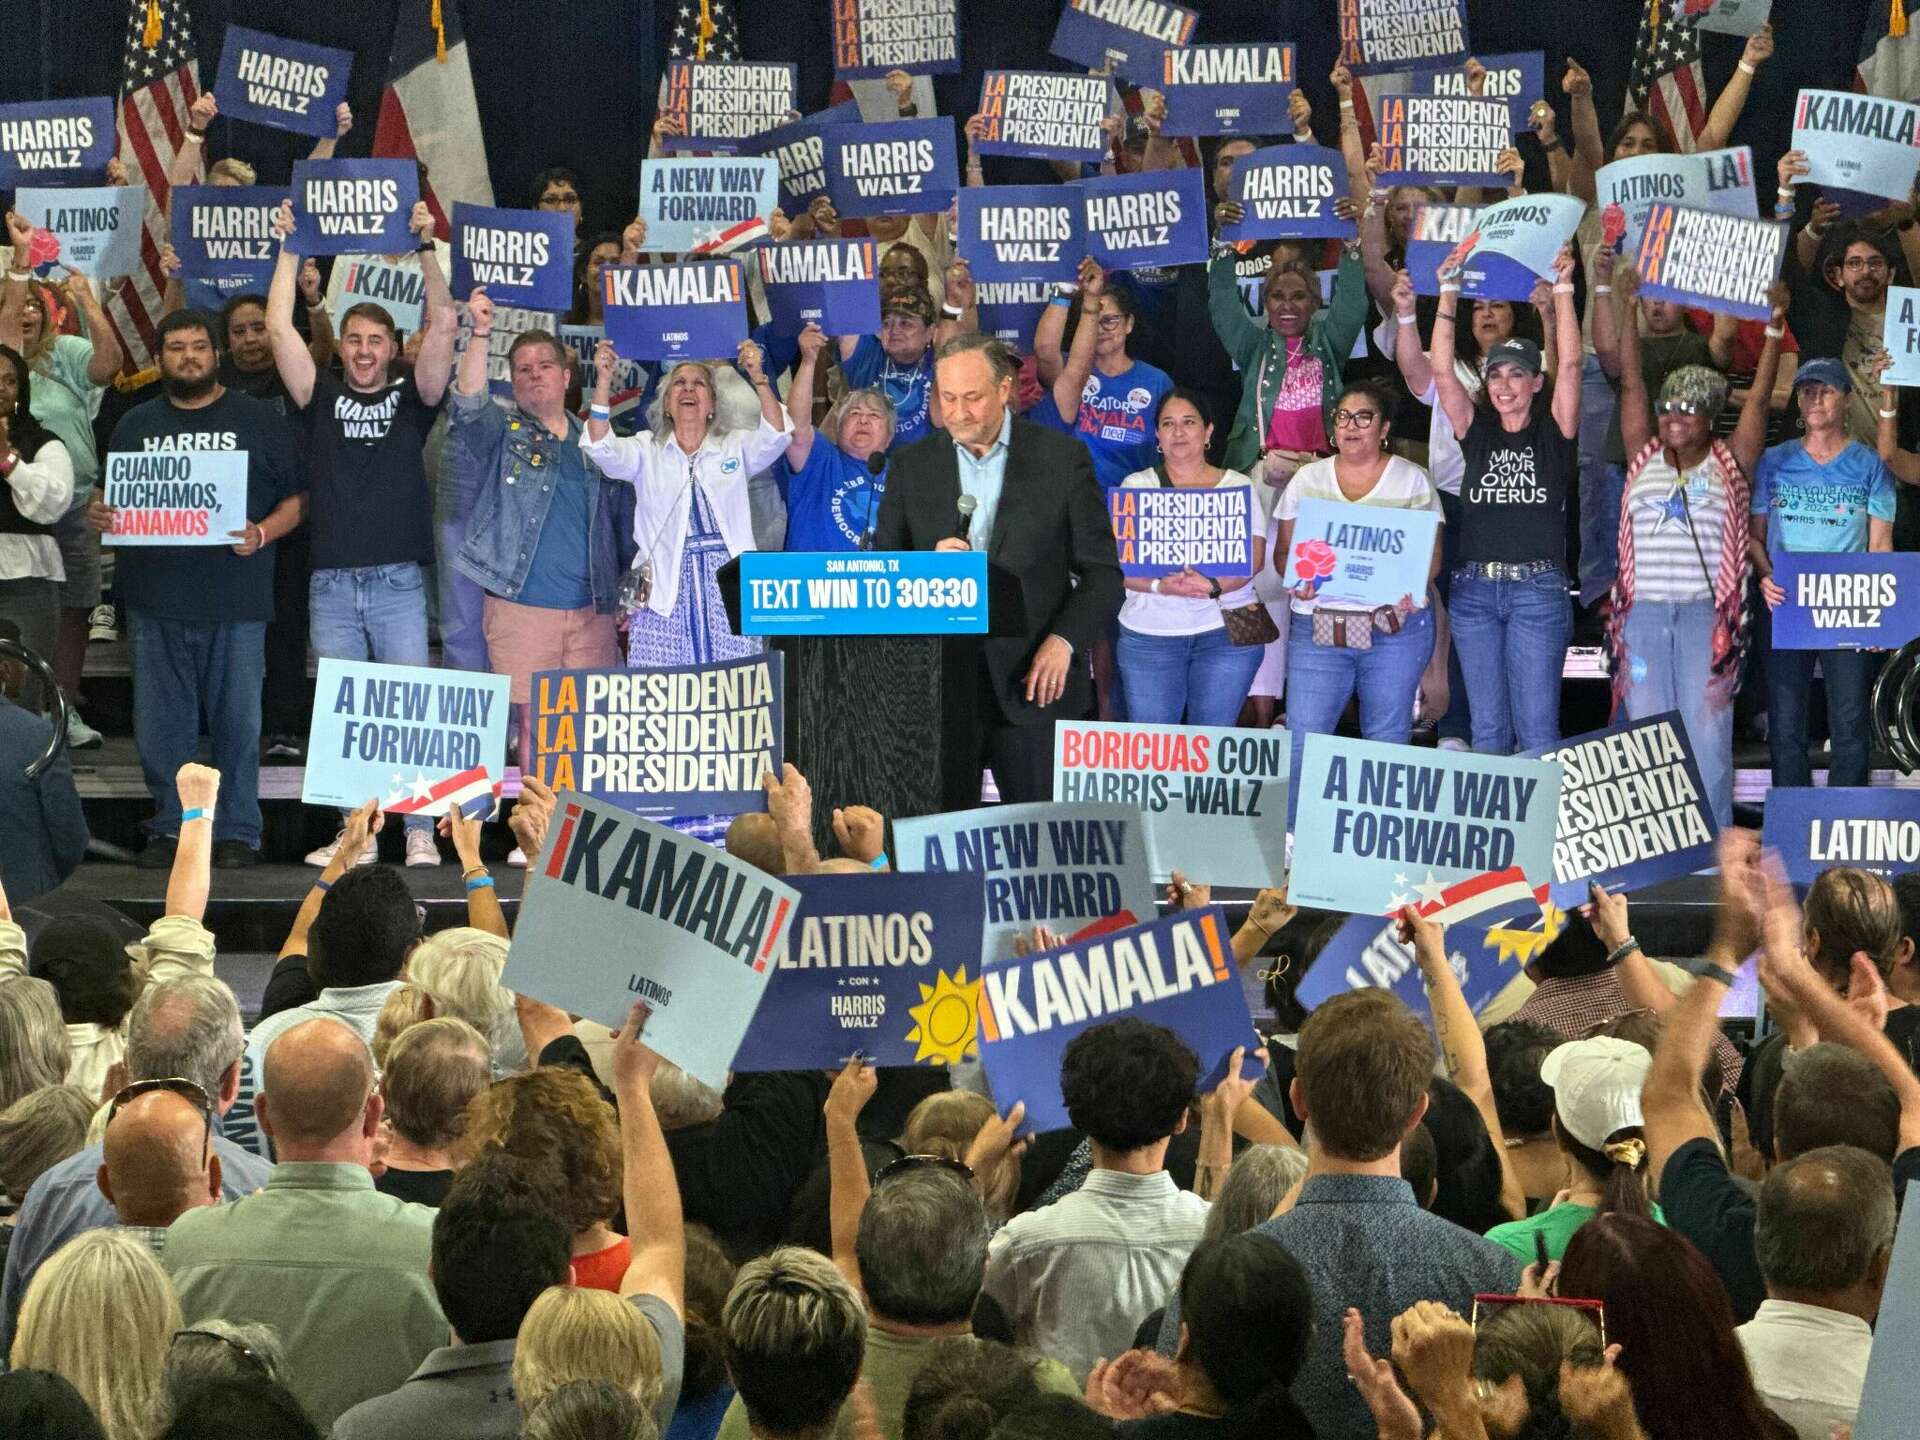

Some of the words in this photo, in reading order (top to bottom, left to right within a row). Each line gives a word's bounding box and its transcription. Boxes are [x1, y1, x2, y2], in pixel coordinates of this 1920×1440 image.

[834, 0, 857, 19] LA
[1341, 16, 1358, 40] LA
[1360, 7, 1462, 39] PRESIDENTA
[836, 21, 858, 44] LA
[860, 13, 956, 43] PRESIDENTA
[838, 44, 859, 68] LA
[861, 37, 956, 66] PRESIDENTA
[1362, 29, 1465, 62] PRESIDENTA
[238, 50, 328, 98] HARRIS
[671, 65, 690, 89] LA
[693, 65, 792, 91] PRESIDENTA
[1164, 48, 1291, 85] ¡KAMALA!
[986, 75, 1006, 96] LA
[1008, 74, 1106, 103] PRESIDENTA
[1434, 69, 1522, 97] HARIS
[248, 84, 310, 115] WALZ
[669, 89, 689, 113] LA
[692, 90, 791, 114] PRESIDENTA
[982, 96, 1001, 117] LA
[1005, 96, 1104, 122] PRESIDENTA
[1383, 99, 1404, 122] LA
[1408, 99, 1511, 128] PRESIDENTA
[2, 117, 93, 151] HARRIS
[1002, 119, 1100, 149] PRESIDENTA
[1382, 124, 1403, 147] LA
[1406, 124, 1510, 150] PRESIDENTA
[18, 149, 81, 169] WALZ
[841, 139, 934, 177] HARRIS
[1405, 149, 1499, 172] PRESIDENT
[652, 168, 665, 192] A
[670, 168, 720, 192] NEW
[721, 168, 764, 192] WAY
[856, 175, 922, 196] WALZ
[1243, 165, 1334, 200] HARRIS
[1612, 173, 1684, 203] LATINOS
[306, 179, 398, 214] HARRIS
[659, 196, 757, 221] FORWARD
[1086, 190, 1181, 231] HARRIS
[1255, 199, 1320, 219] WALZ
[46, 207, 119, 233] LATINOS
[192, 206, 282, 239] HARRIS
[319, 215, 384, 234] WALZ
[981, 207, 1071, 241] HARRIS
[1474, 206, 1551, 232] LATINOS
[1649, 203, 1673, 232] LA
[1676, 208, 1781, 255] PRESIDENTA
[206, 241, 271, 259] WALZ
[463, 225, 549, 266] HARRIS
[995, 243, 1060, 262] WALZ
[1102, 226, 1169, 250] WALZ
[760, 242, 873, 283] ¡KAMALA!
[1642, 231, 1666, 257] LA
[1668, 235, 1777, 282] PRESIDENTA
[472, 263, 534, 286] WALZ
[605, 264, 741, 306] ¡KAMALA!
[1662, 263, 1769, 307] PRESIDENTA
[1899, 298, 1914, 323] A
[143, 432, 237, 452] HARRIS
[1104, 428, 1124, 440] nea
[112, 456, 191, 482] CUANDO
[1489, 447, 1534, 462] MIND
[1489, 461, 1535, 476] YOUR
[1481, 473, 1536, 487] OWN
[109, 483, 222, 513] LUCHAMOS,
[1113, 492, 1135, 516] LA
[1139, 492, 1246, 516] PRESIDENTA
[1470, 488, 1547, 503] UTERUS
[1804, 504, 1830, 512] 2024
[111, 510, 209, 537] GANAMOS
[1114, 517, 1135, 539] LA
[1138, 516, 1246, 540] PRESIDENTA
[1326, 521, 1405, 554] LATINOS
[826, 560, 845, 573] SAN
[846, 560, 886, 574] ANTONIO,
[887, 560, 899, 572] TX
[1138, 540, 1246, 565] PRESIDENTA
[750, 579, 801, 609] TEXT
[808, 579, 857, 608] WIN
[863, 579, 890, 608] TO
[896, 578, 978, 608] 30330
[1798, 573, 1897, 606] HARRIS
[1812, 609, 1880, 628] WALZ
[334, 676, 355, 715] A
[363, 678, 431, 722] NEW
[438, 685, 494, 728] WAY
[539, 676, 579, 716] LA
[586, 662, 774, 713] PRESIDENTA
[537, 715, 577, 753] LA
[584, 706, 775, 752] PRESIDENTA
[341, 721, 481, 771] FORWARD
[1063, 729, 1210, 773] BORICUAS
[1218, 737, 1280, 776] CON
[582, 751, 774, 793] PRESIDENTA
[1322, 755, 1348, 801] A
[1357, 759, 1445, 813] NEW
[1454, 770, 1538, 822] WAY
[1556, 761, 1698, 839] ESIDENTA
[924, 834, 948, 871] A
[955, 822, 1039, 871] NEW
[1048, 820, 1128, 865] WAY
[1332, 808, 1515, 873] FORWARD
[1552, 803, 1712, 885] RESIDENTA
[1810, 820, 1920, 862] LATINO
[545, 802, 791, 974] ¡KAMALA!
[986, 872, 1122, 923] RWARD
[778, 911, 934, 969] LATINOS
[628, 974, 672, 1007] LATINOS
[849, 977, 869, 985] CON
[979, 914, 1230, 1043] ¡KAMALA!
[831, 994, 886, 1016] HARRIS
[840, 1016, 878, 1028] WALZ
